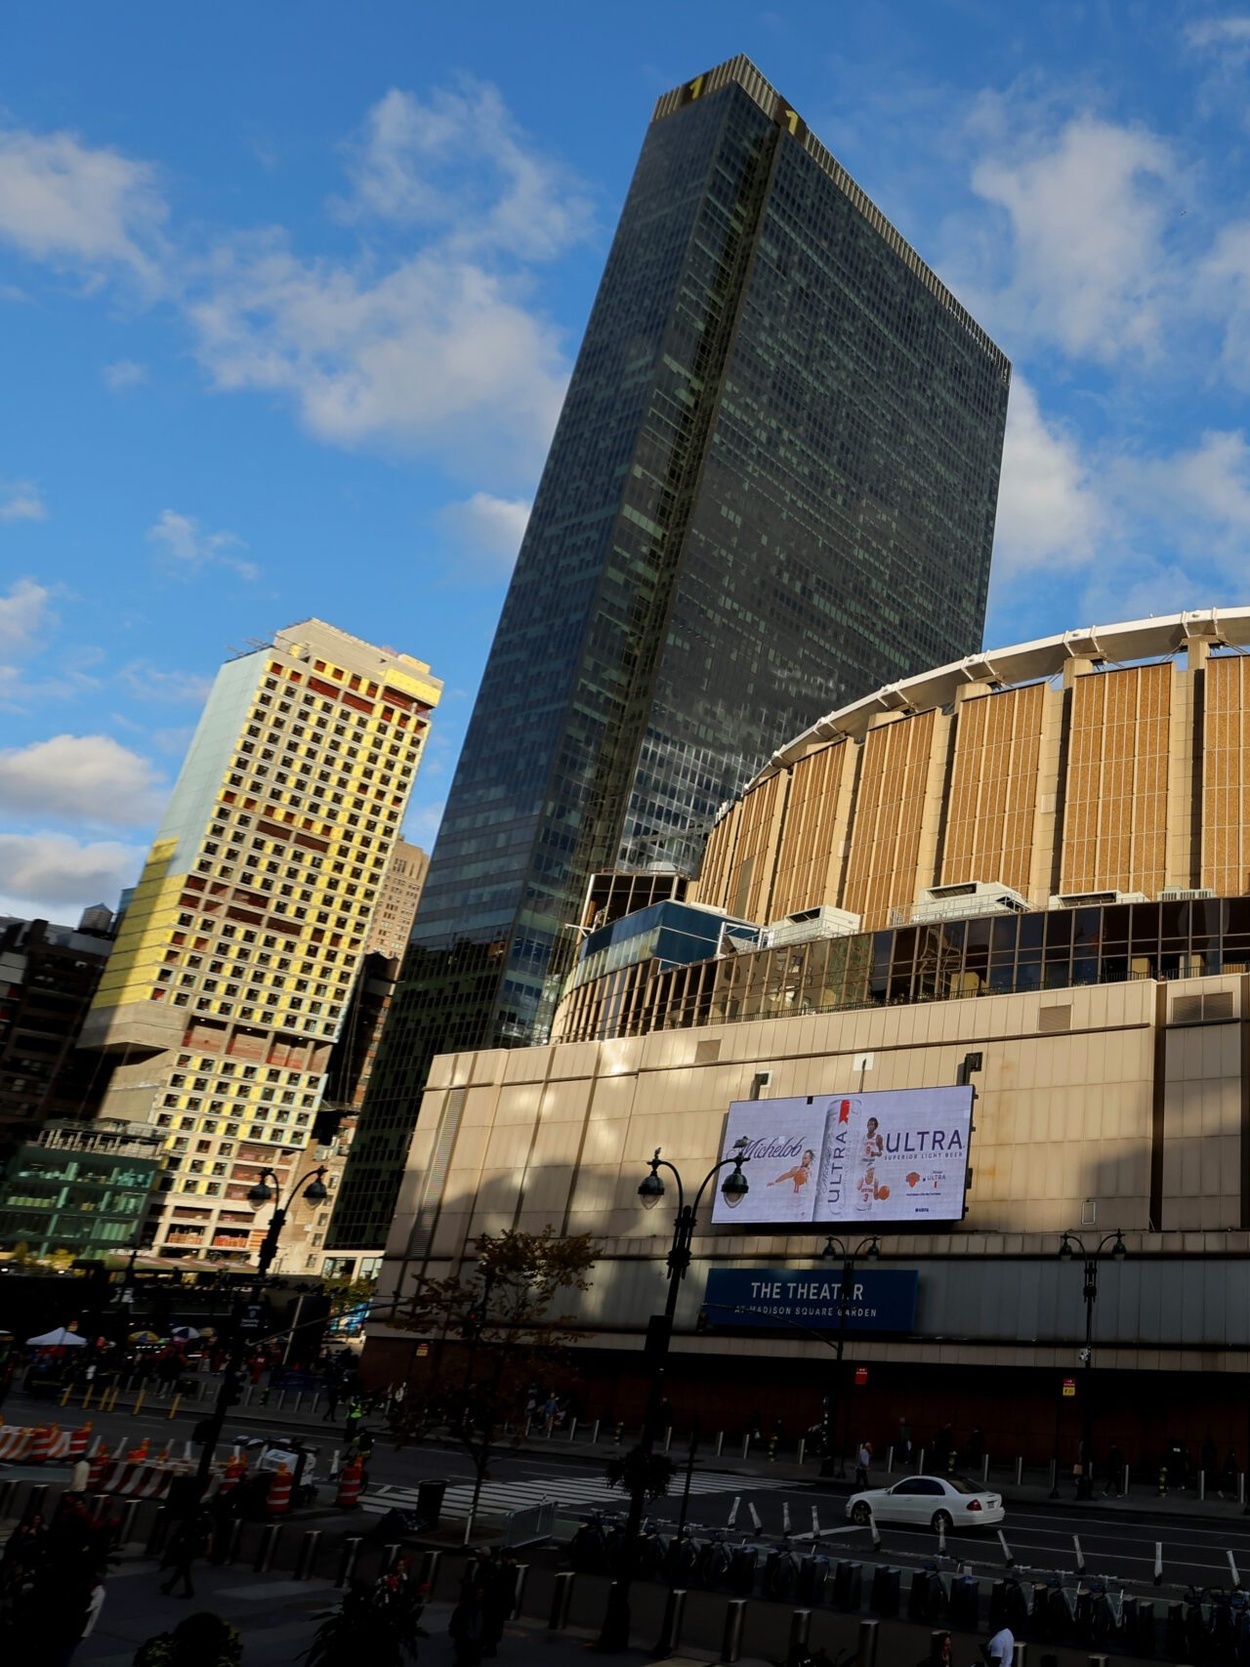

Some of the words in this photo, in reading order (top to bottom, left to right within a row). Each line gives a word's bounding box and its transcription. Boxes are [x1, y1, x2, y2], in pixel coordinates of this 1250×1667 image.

[726, 1136, 806, 1159] Michelob
[886, 1129, 963, 1153] ULTRA
[827, 1131, 847, 1203] ULTRA
[751, 1282, 782, 1298] THE
[787, 1283, 863, 1300] THEATR
[795, 1306, 833, 1316] SQUARE
